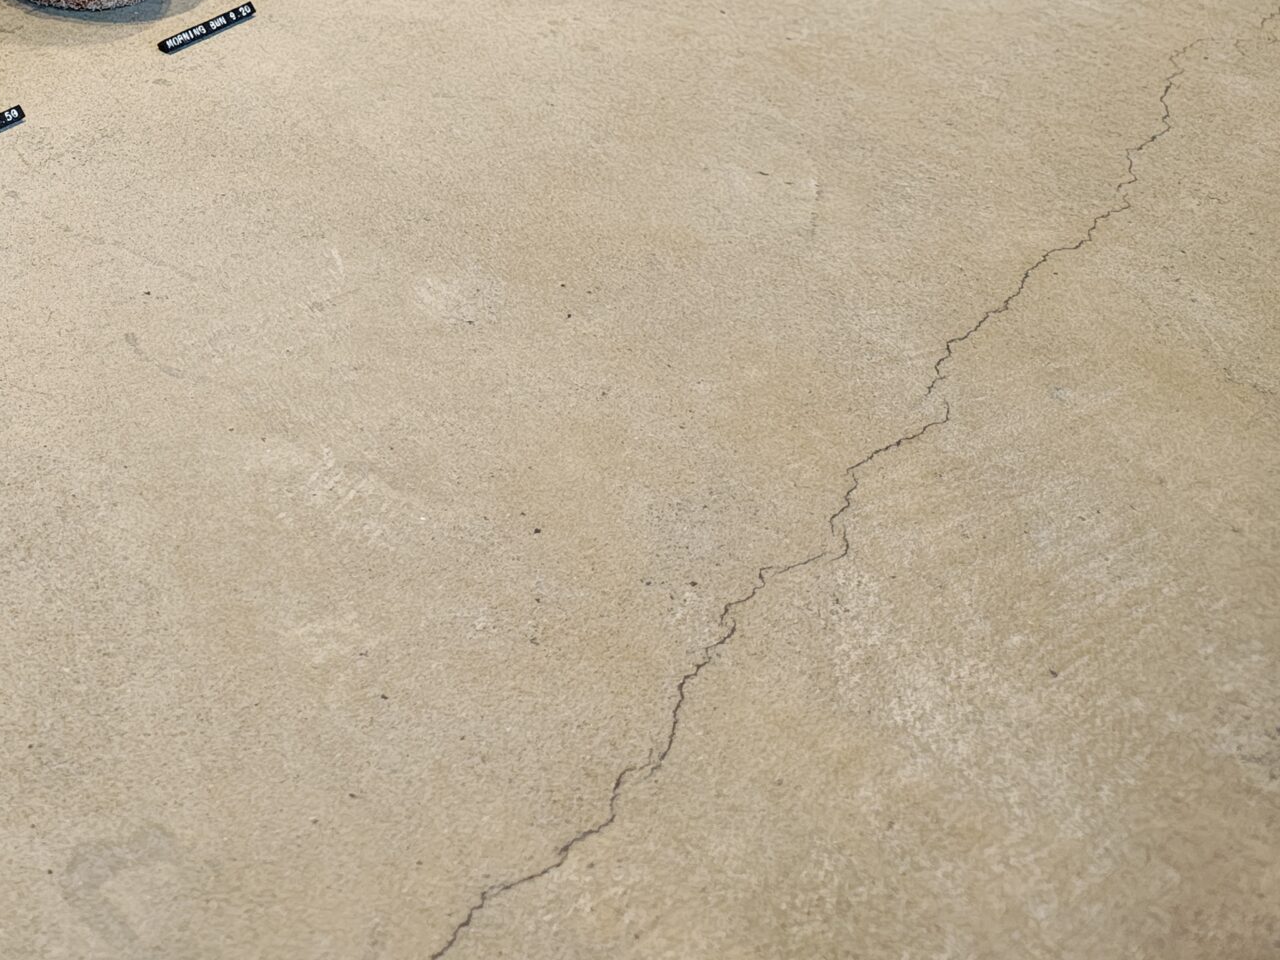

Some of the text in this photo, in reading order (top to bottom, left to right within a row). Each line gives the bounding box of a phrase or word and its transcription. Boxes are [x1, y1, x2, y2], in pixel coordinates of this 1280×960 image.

[166, 5, 251, 49] MORNING BUN 9.20
